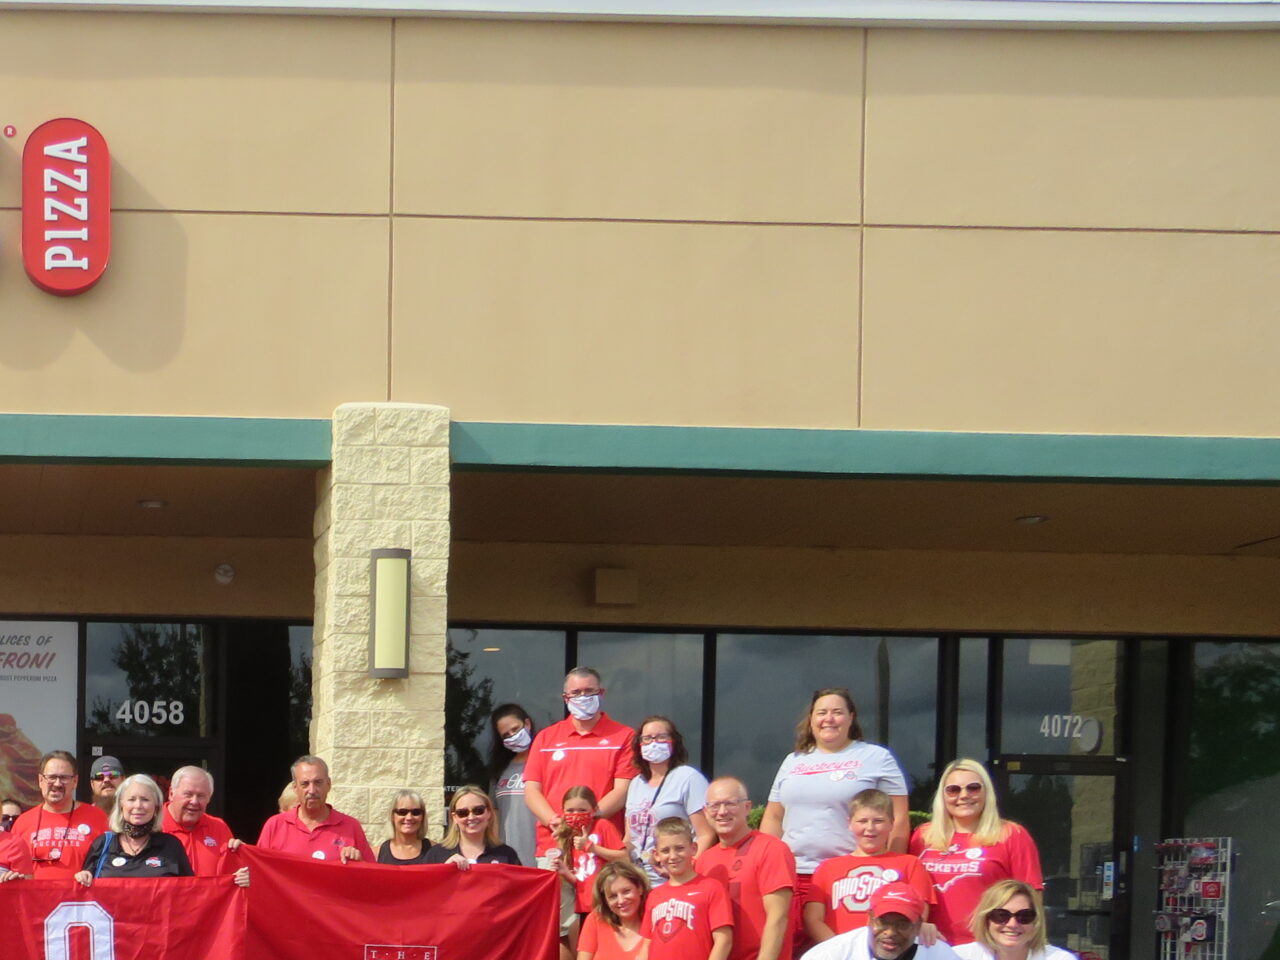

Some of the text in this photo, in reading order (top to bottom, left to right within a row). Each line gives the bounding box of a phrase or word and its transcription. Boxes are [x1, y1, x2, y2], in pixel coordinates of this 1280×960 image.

[43, 136, 89, 271] PIZZA
[36, 635, 53, 646] OF
[116, 700, 184, 725] 4058
[1040, 715, 1082, 738] 4072
[923, 861, 980, 873] CKEYES
